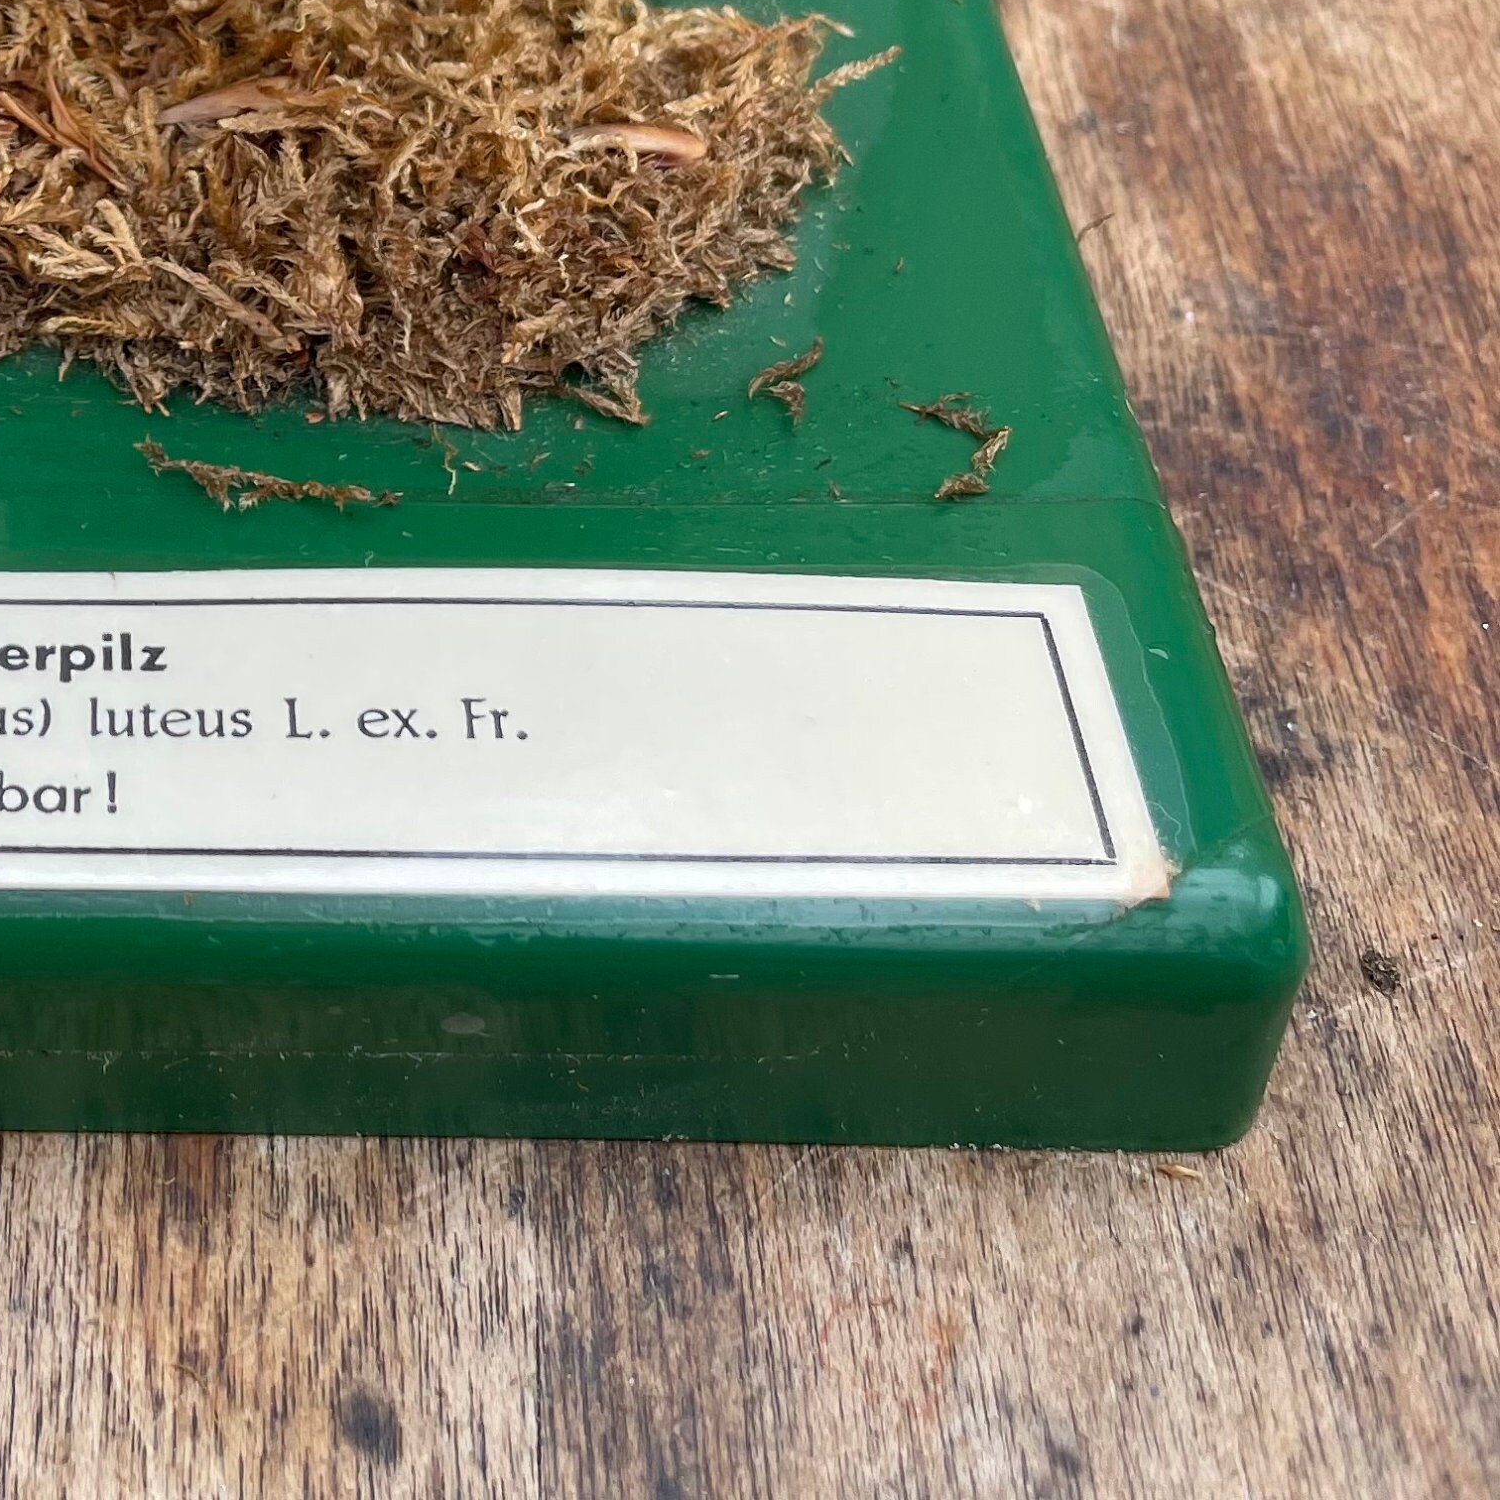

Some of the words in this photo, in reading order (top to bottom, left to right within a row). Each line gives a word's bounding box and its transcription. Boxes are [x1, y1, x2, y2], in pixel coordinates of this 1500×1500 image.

[89, 696, 253, 740] luteus
[283, 697, 331, 740] L.
[356, 708, 438, 740] ex.
[460, 697, 529, 741] Fr.
